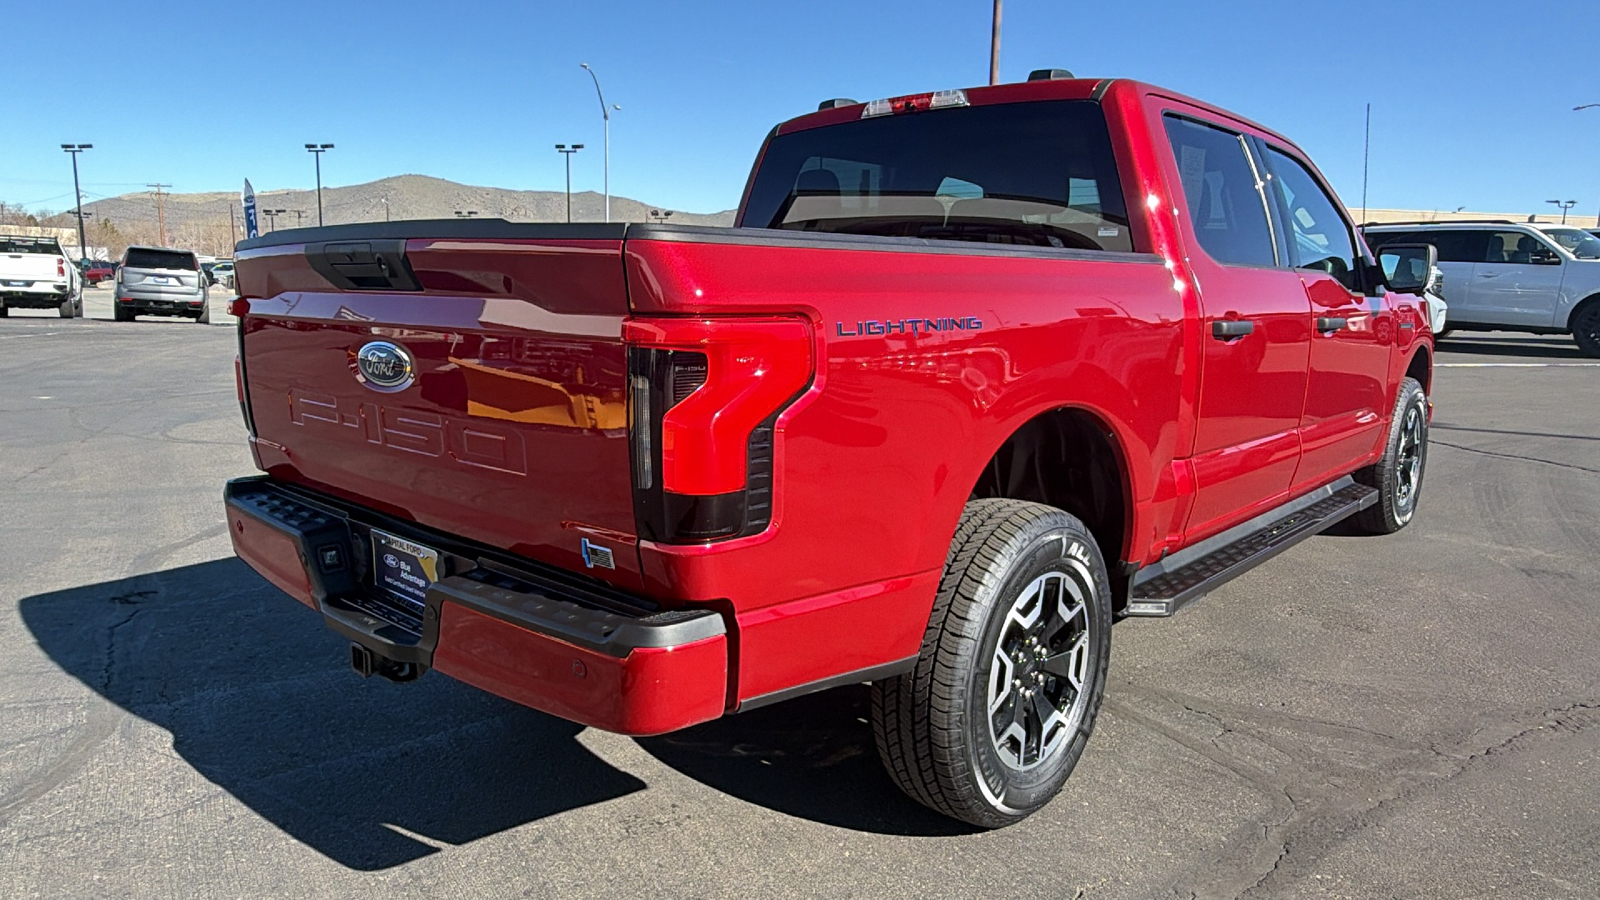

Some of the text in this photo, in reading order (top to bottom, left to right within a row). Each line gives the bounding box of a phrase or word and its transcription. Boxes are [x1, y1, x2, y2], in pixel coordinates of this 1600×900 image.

[836, 317, 983, 338] LIGHTNING
[366, 350, 396, 376] Ford
[288, 388, 527, 476] F-150
[406, 543, 422, 555] FORD
[1066, 541, 1091, 567] ALL
[400, 561, 411, 572] Blue
